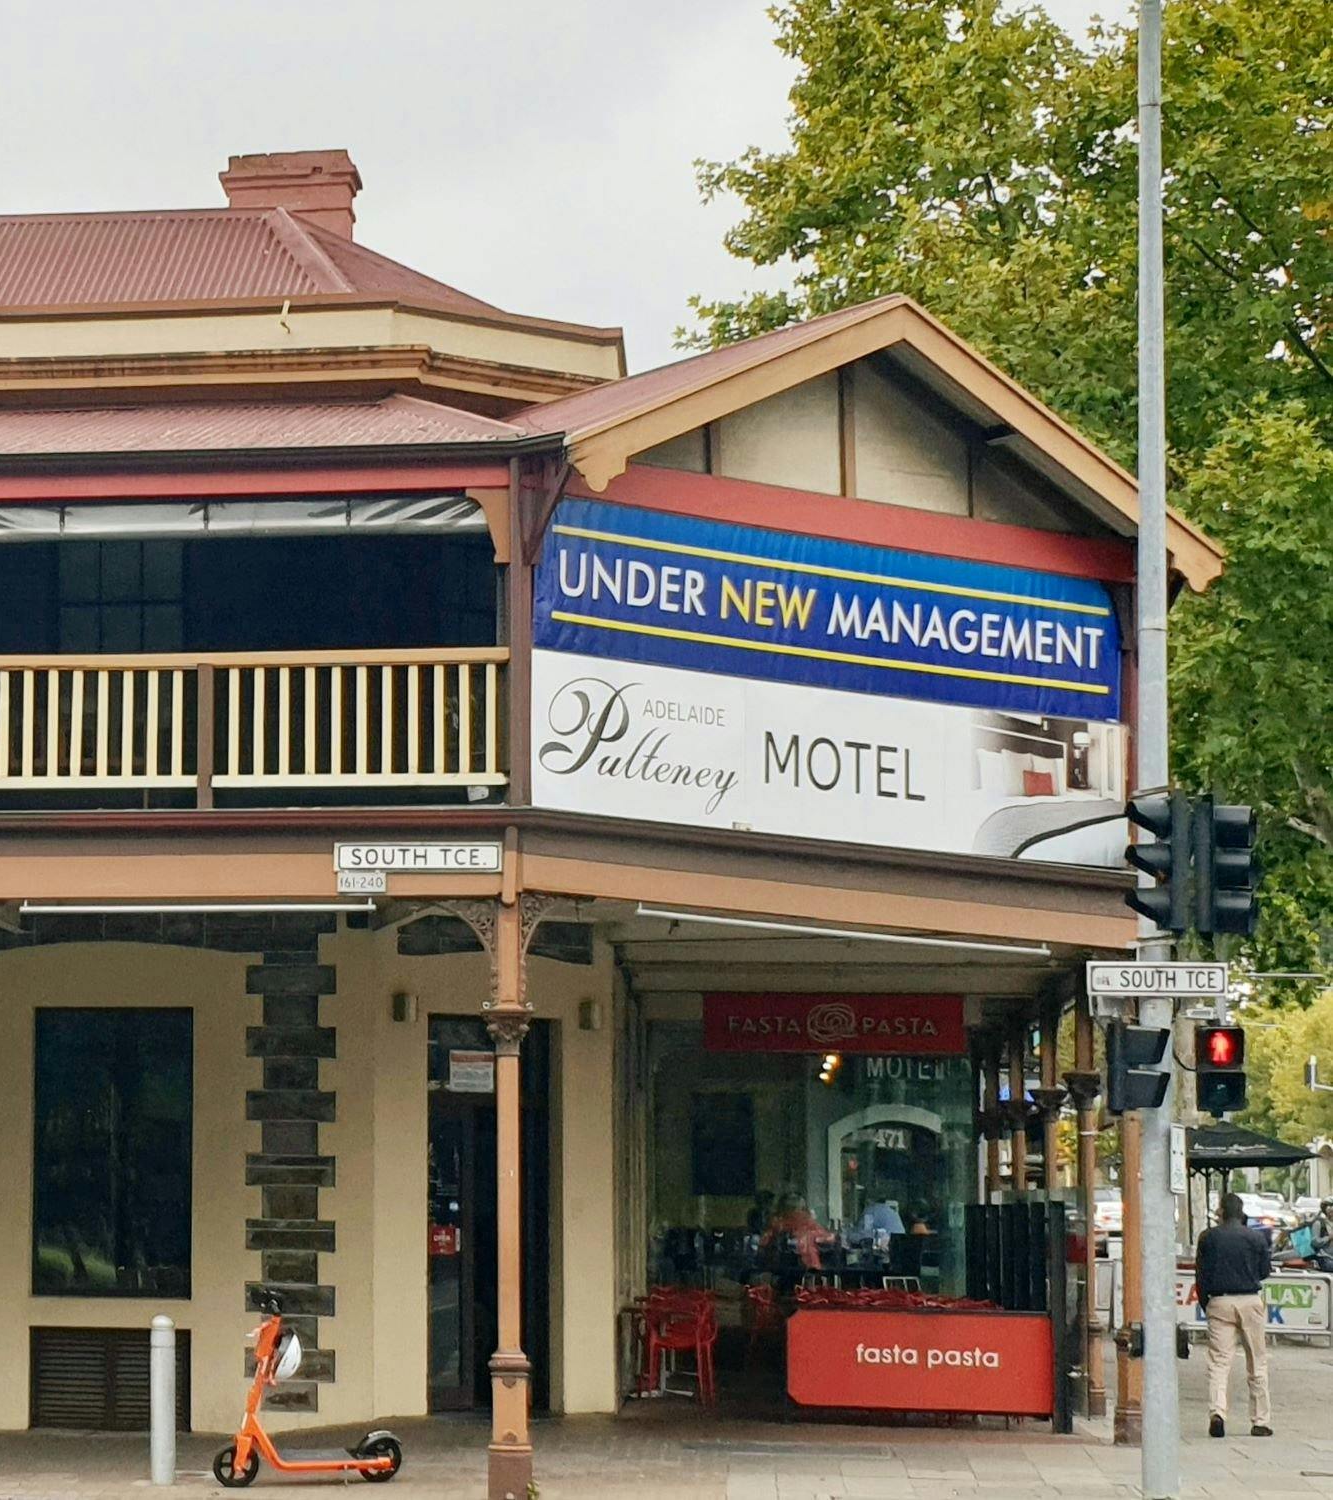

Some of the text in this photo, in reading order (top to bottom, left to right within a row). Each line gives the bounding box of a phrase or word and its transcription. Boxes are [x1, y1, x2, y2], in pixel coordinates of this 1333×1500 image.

[558, 549, 1105, 670] UNDER NEW MANAGEMENT
[642, 698, 725, 728] ADELAIDE
[539, 677, 926, 815] Pulteney MOTEL
[351, 848, 427, 866] SOUTH
[1120, 970, 1176, 989] SOUTH
[1186, 970, 1217, 989] TCE
[727, 1015, 938, 1037] FASTA PASTA
[1266, 1287, 1313, 1306] LAY
[856, 1343, 999, 1369] fasta pasta
